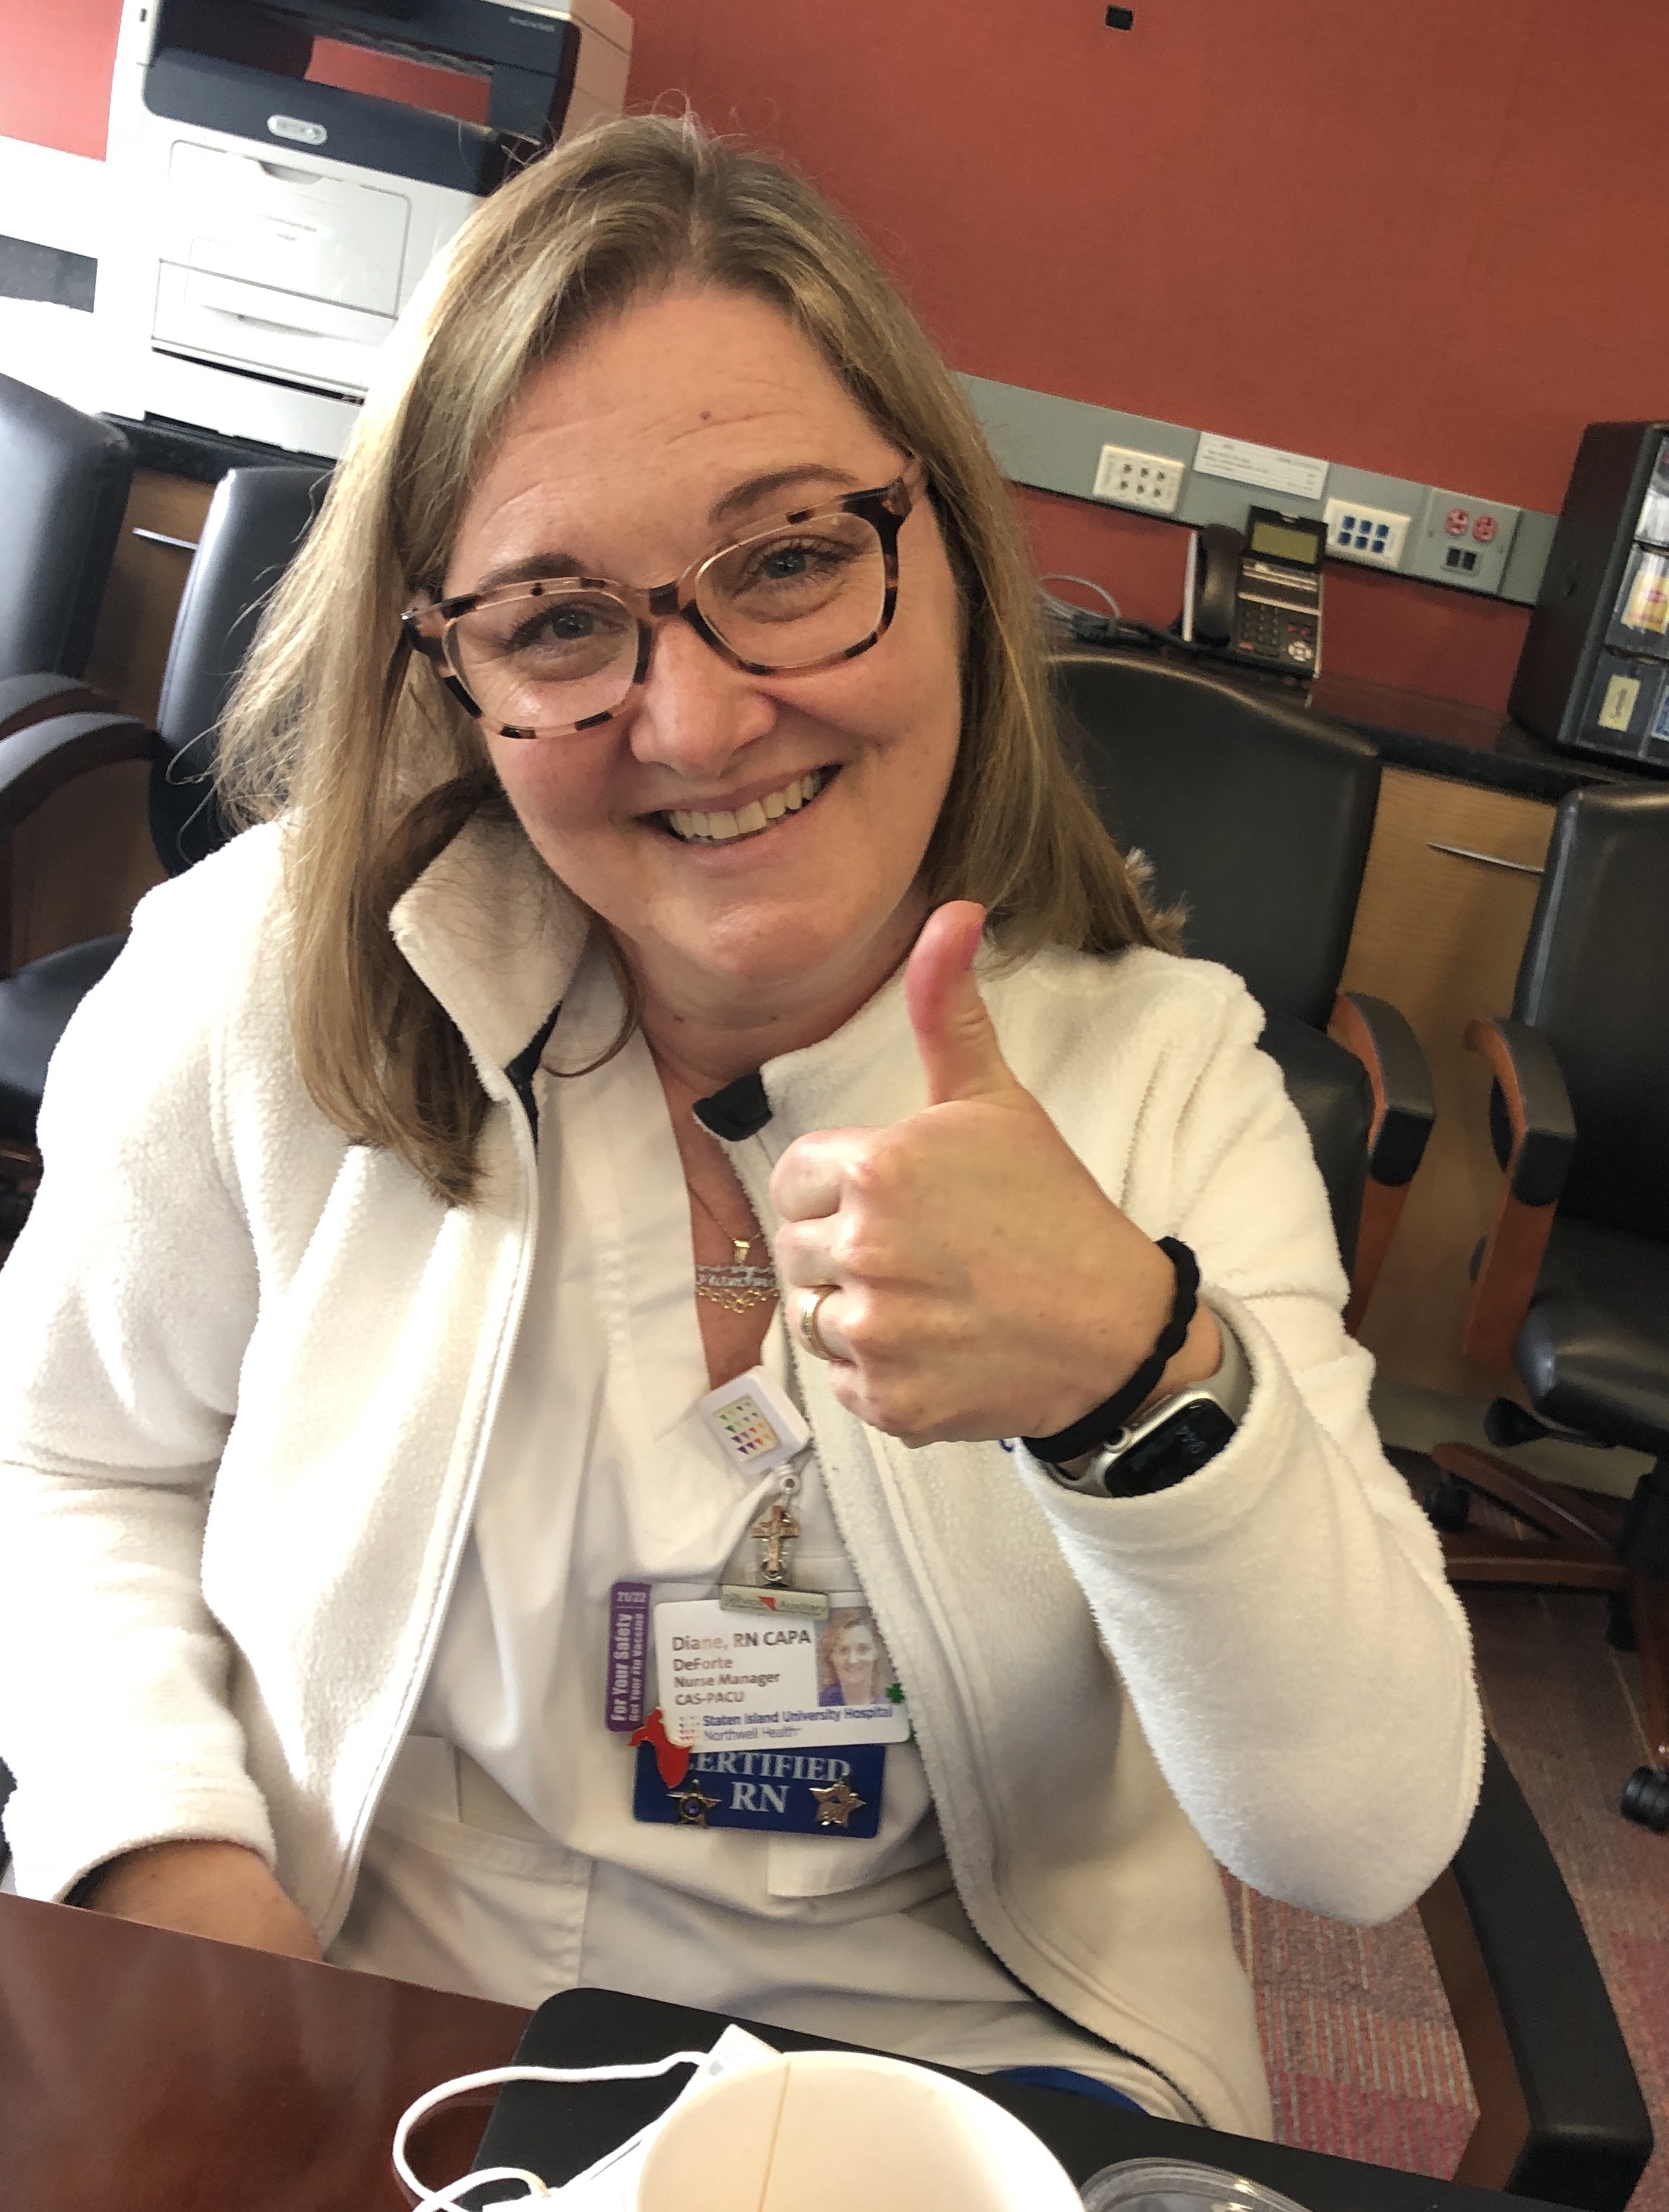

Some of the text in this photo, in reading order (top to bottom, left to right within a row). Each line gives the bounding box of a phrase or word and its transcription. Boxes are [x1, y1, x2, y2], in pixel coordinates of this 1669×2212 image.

[672, 1629, 812, 1651] Diane, RN CAPA
[611, 1613, 632, 1721] For Your Safety
[672, 1658, 733, 1671] DeForte
[674, 1674, 781, 1687] Nurse Manager
[675, 1691, 745, 1705] CAS-PACU
[703, 1706, 893, 1726] Staten Island University Hospital
[703, 1726, 802, 1741] Northwell Health
[730, 1782, 790, 1813] RN
